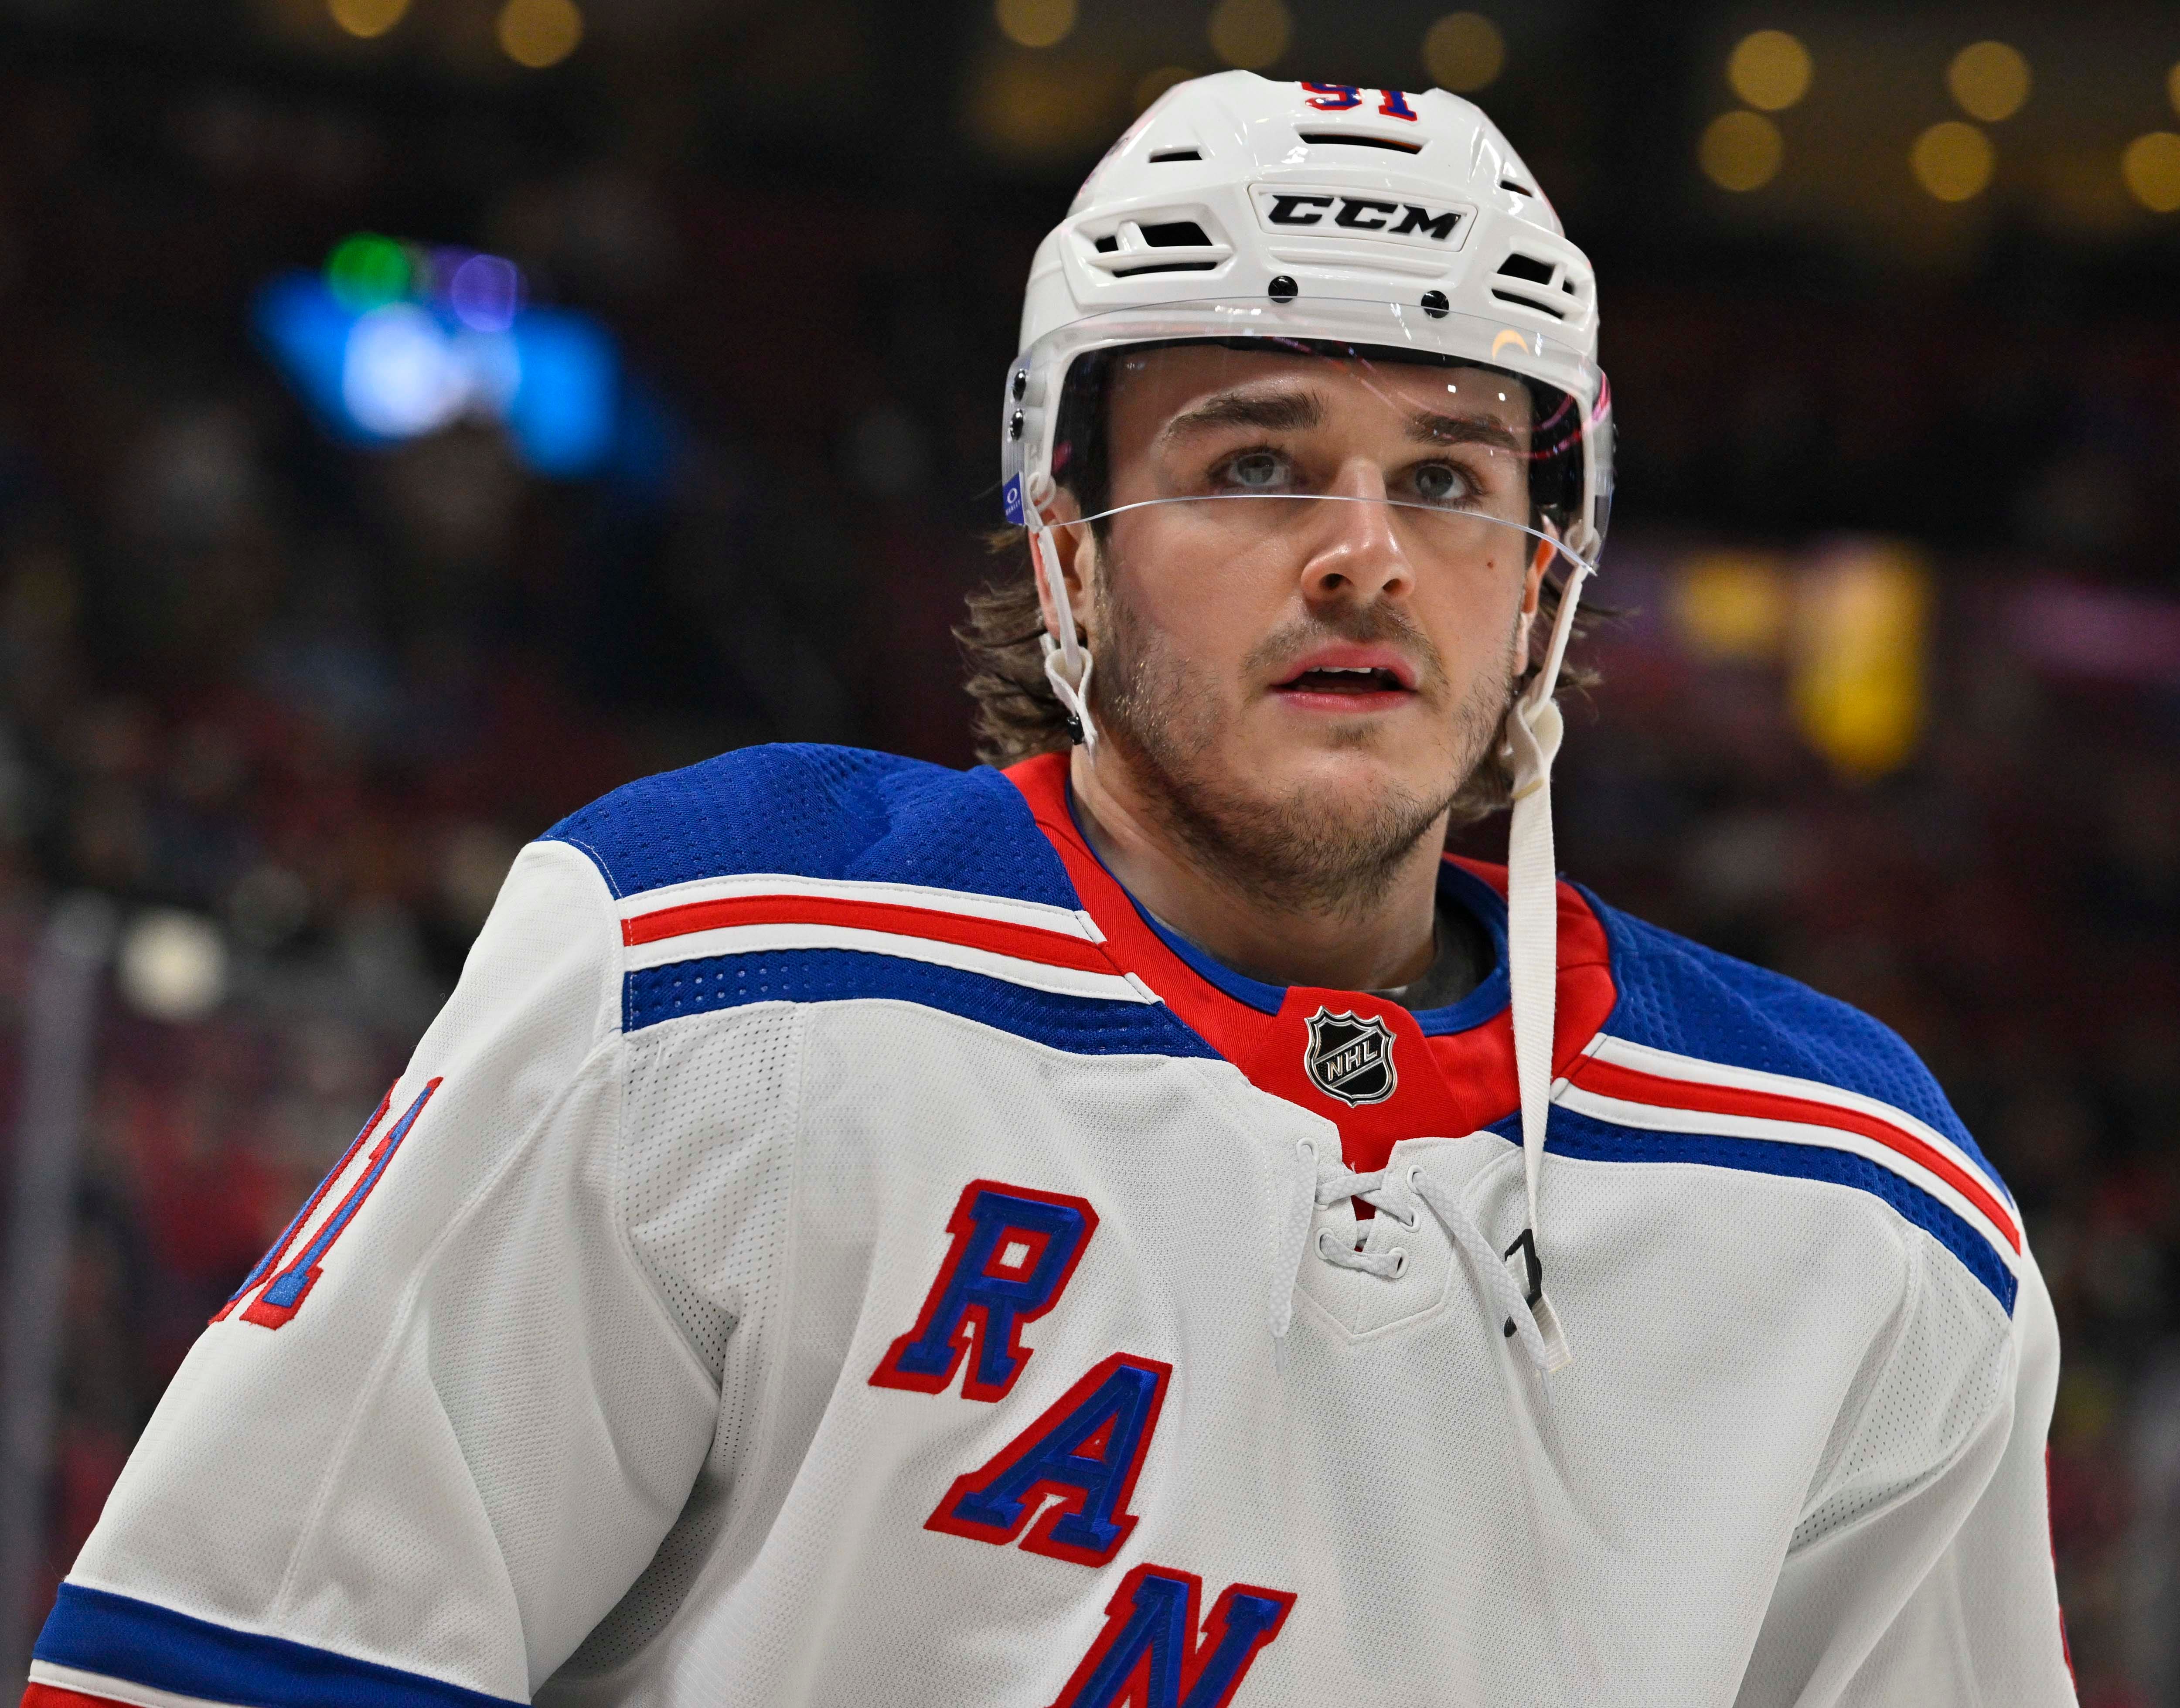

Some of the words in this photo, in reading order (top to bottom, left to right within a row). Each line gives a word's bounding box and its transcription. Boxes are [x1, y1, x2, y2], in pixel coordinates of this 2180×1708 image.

[1269, 195, 1461, 239] CCM
[1326, 1041, 1377, 1081] NHL
[208, 1077, 443, 1330] 1
